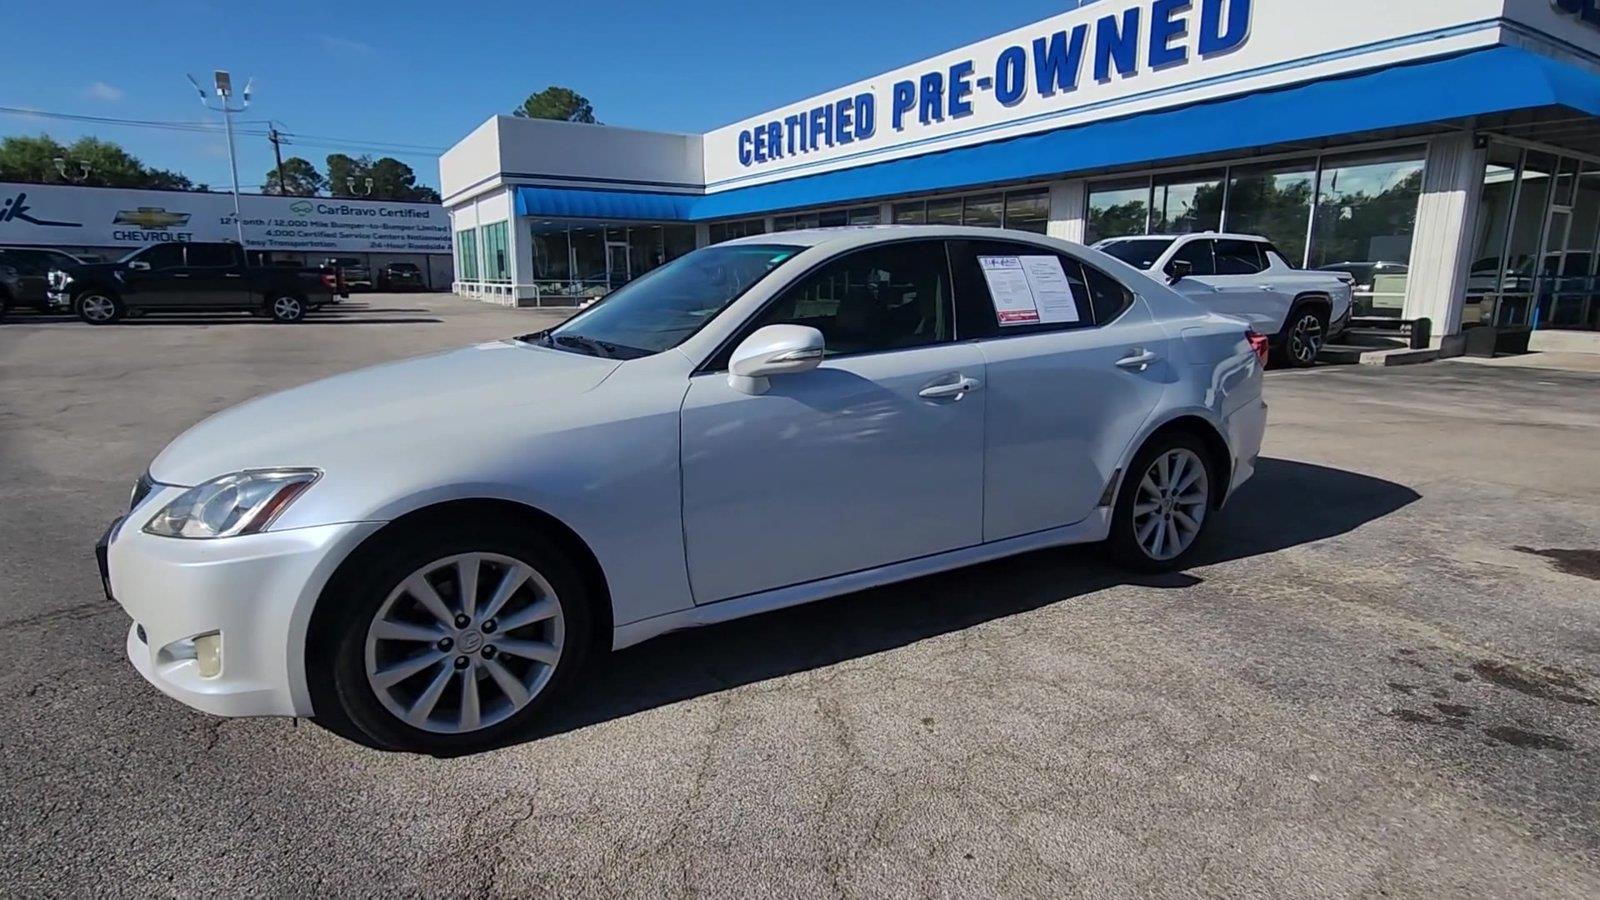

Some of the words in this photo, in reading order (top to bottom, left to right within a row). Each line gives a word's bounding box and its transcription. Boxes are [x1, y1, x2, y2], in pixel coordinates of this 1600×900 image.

[738, 92, 876, 167] CERTIFIED
[891, 0, 1253, 132] PRE-OWNED
[317, 204, 376, 217] CarBravo
[379, 208, 430, 219] Certified
[220, 217, 231, 225] 12
[113, 231, 193, 242] CHEVROLET
